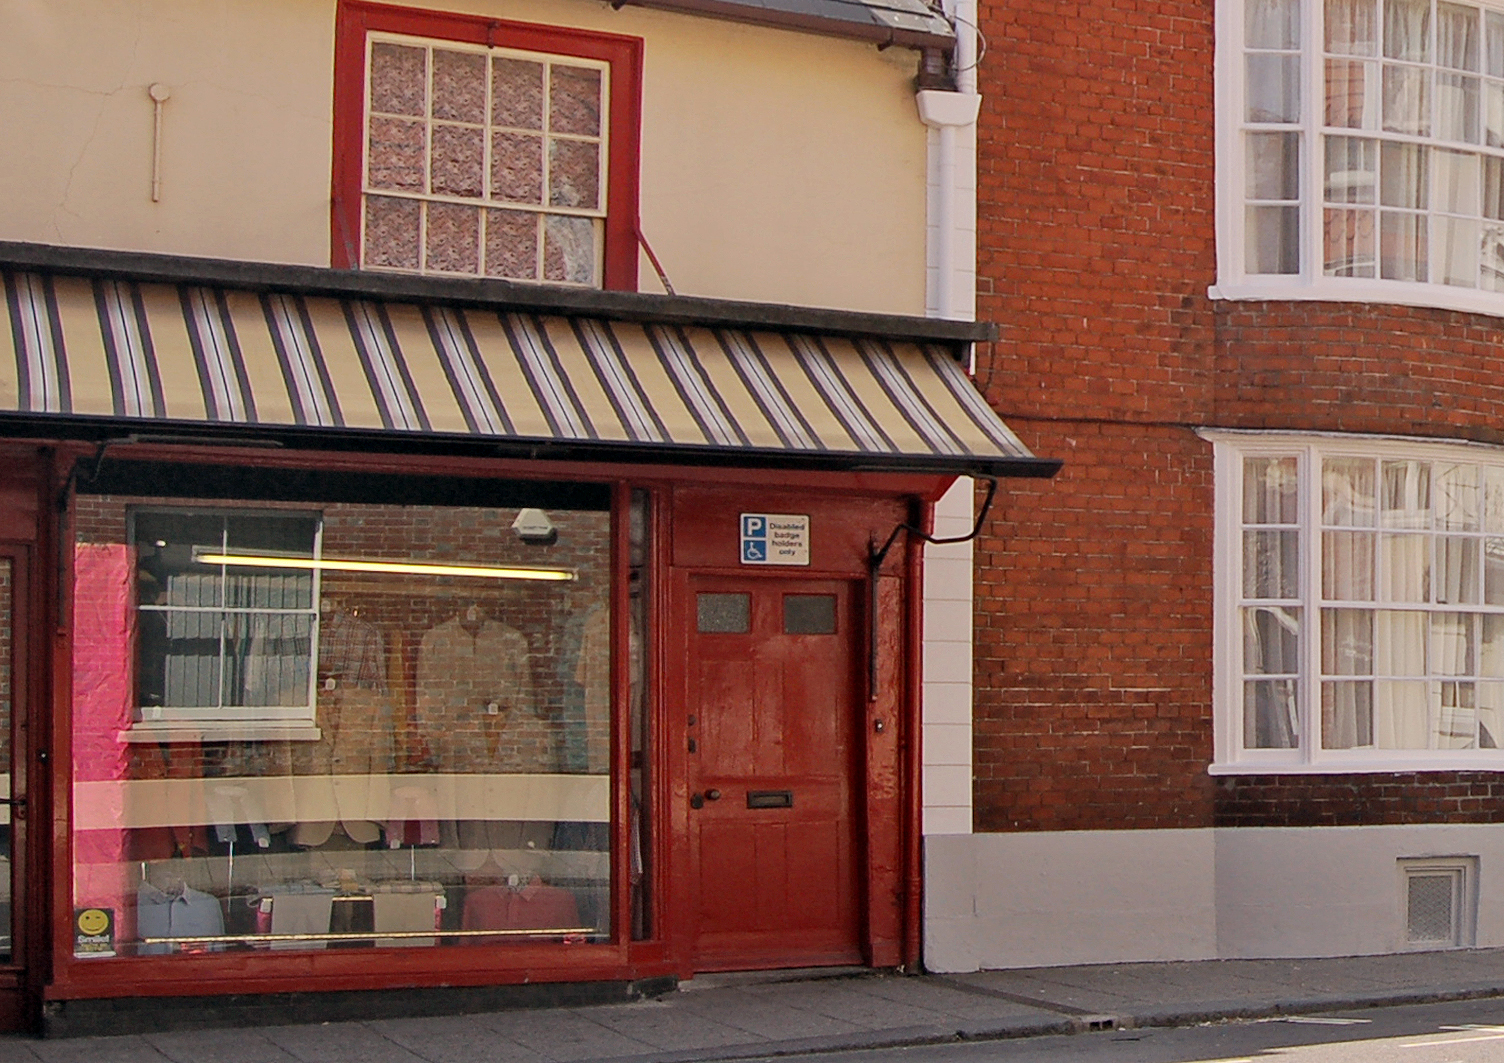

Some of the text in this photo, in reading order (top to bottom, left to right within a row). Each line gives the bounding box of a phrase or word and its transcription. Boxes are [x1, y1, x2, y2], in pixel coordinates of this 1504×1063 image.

[747, 518, 762, 536] P
[769, 523, 805, 531] Disabled
[774, 531, 800, 539] badge
